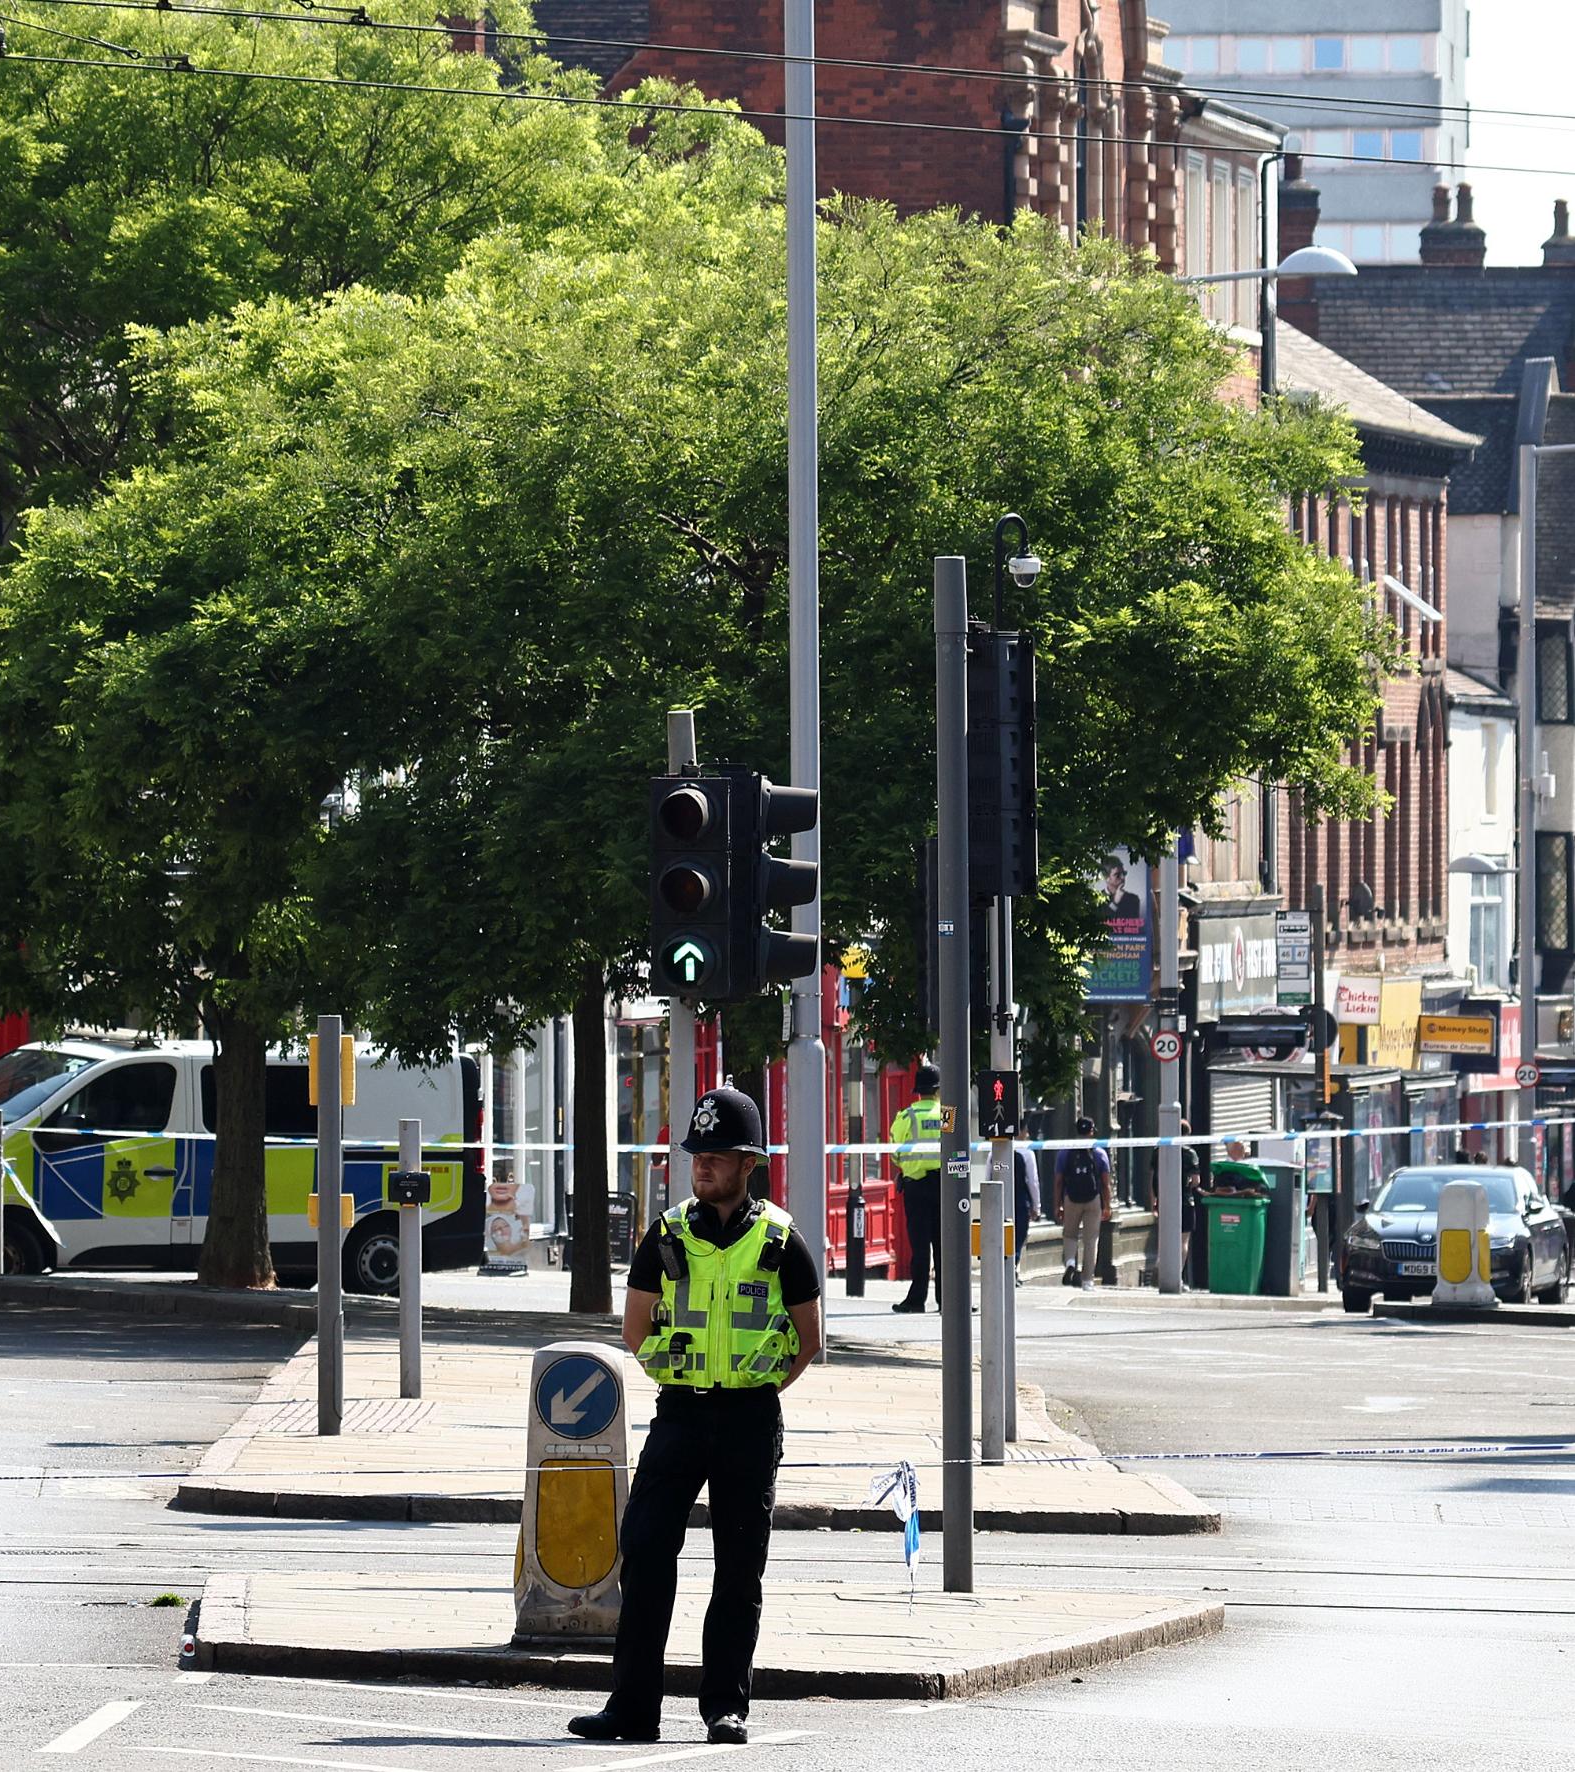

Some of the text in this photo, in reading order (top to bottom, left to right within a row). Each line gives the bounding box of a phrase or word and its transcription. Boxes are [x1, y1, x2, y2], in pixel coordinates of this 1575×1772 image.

[1438, 1025, 1490, 1035] Money Shop
[1156, 1040, 1178, 1053] 20
[1519, 1070, 1537, 1082] 20
[740, 1285, 766, 1297] POLICE
